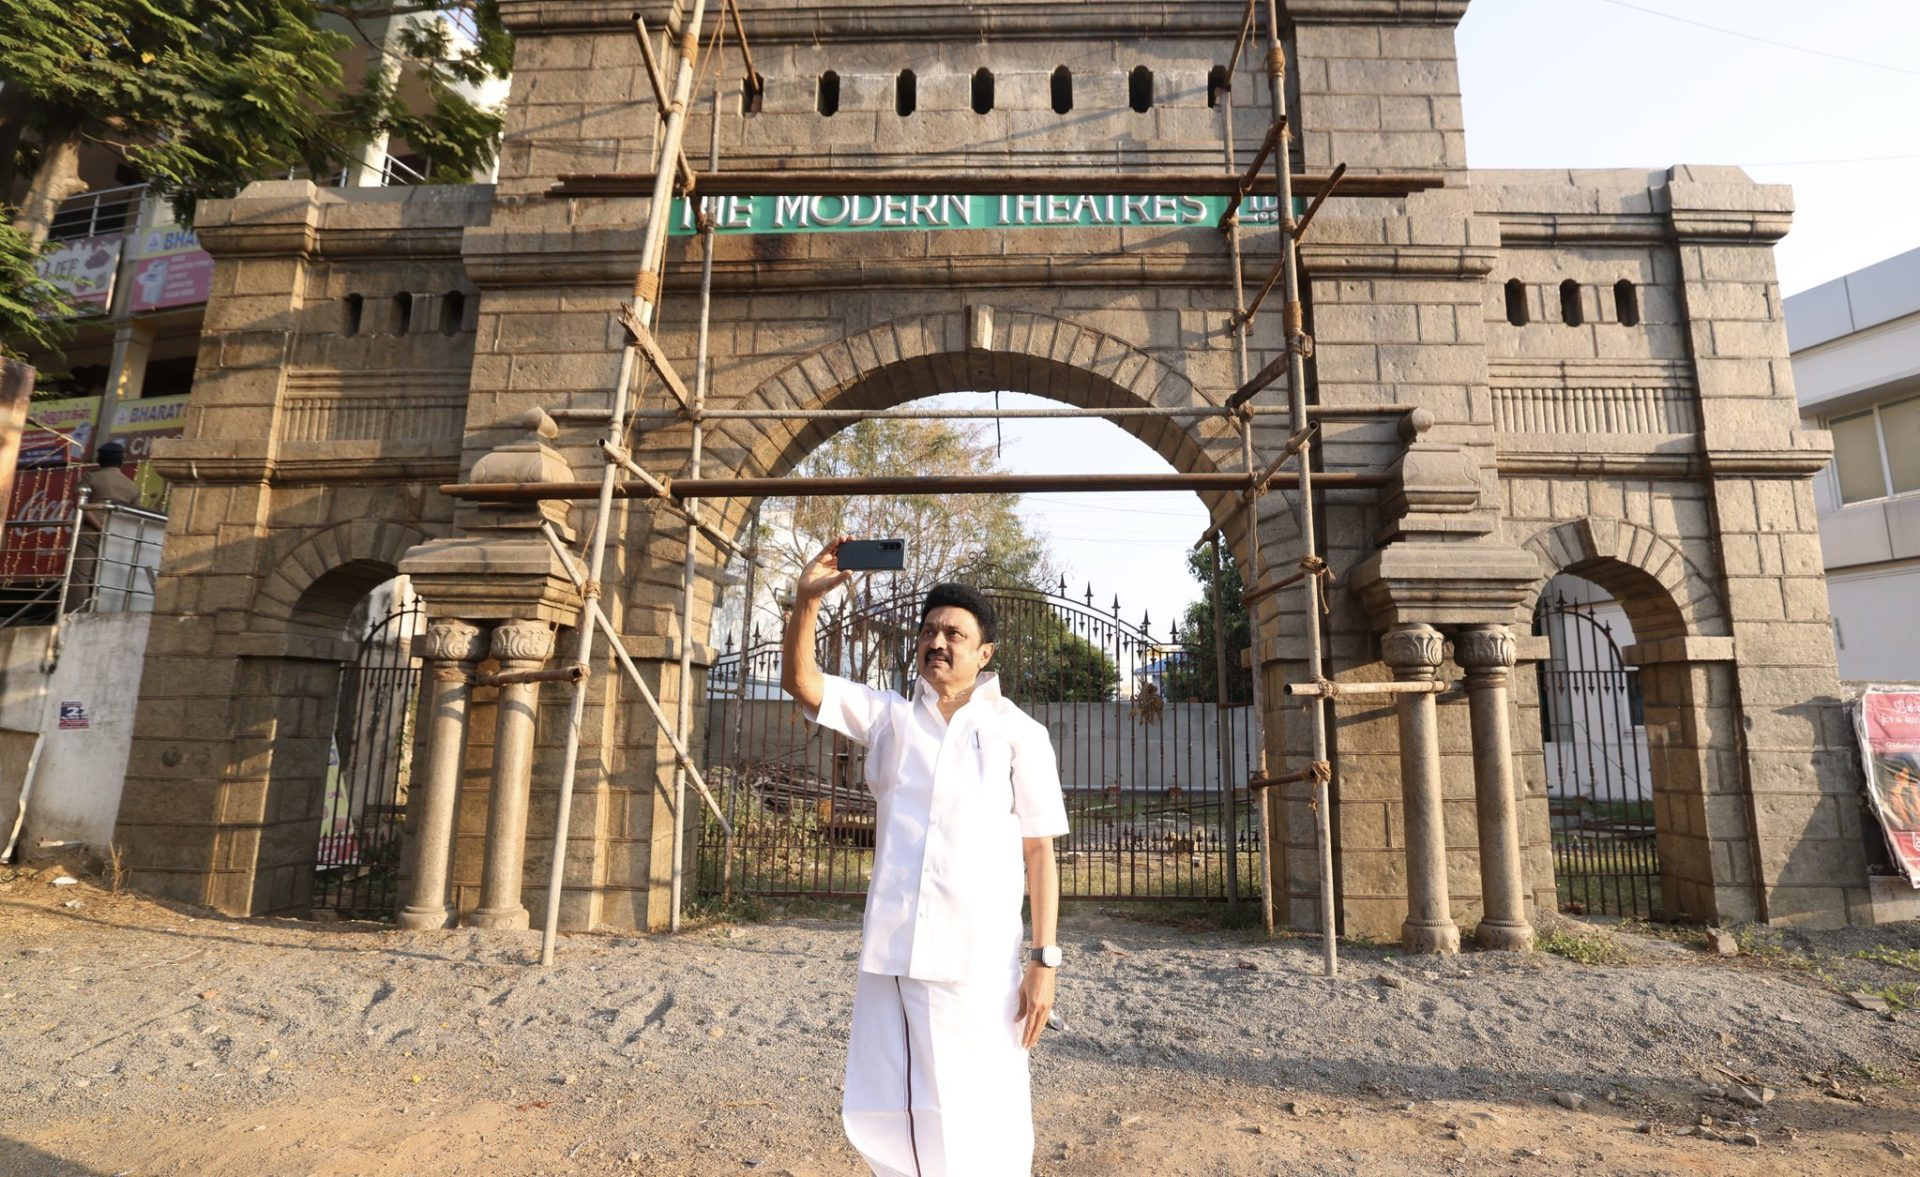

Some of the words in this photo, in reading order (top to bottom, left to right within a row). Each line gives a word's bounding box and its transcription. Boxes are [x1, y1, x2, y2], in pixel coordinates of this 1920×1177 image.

[774, 195, 970, 227] MODERN
[997, 195, 1207, 224] THEATRES
[130, 403, 184, 423] BHARAT
